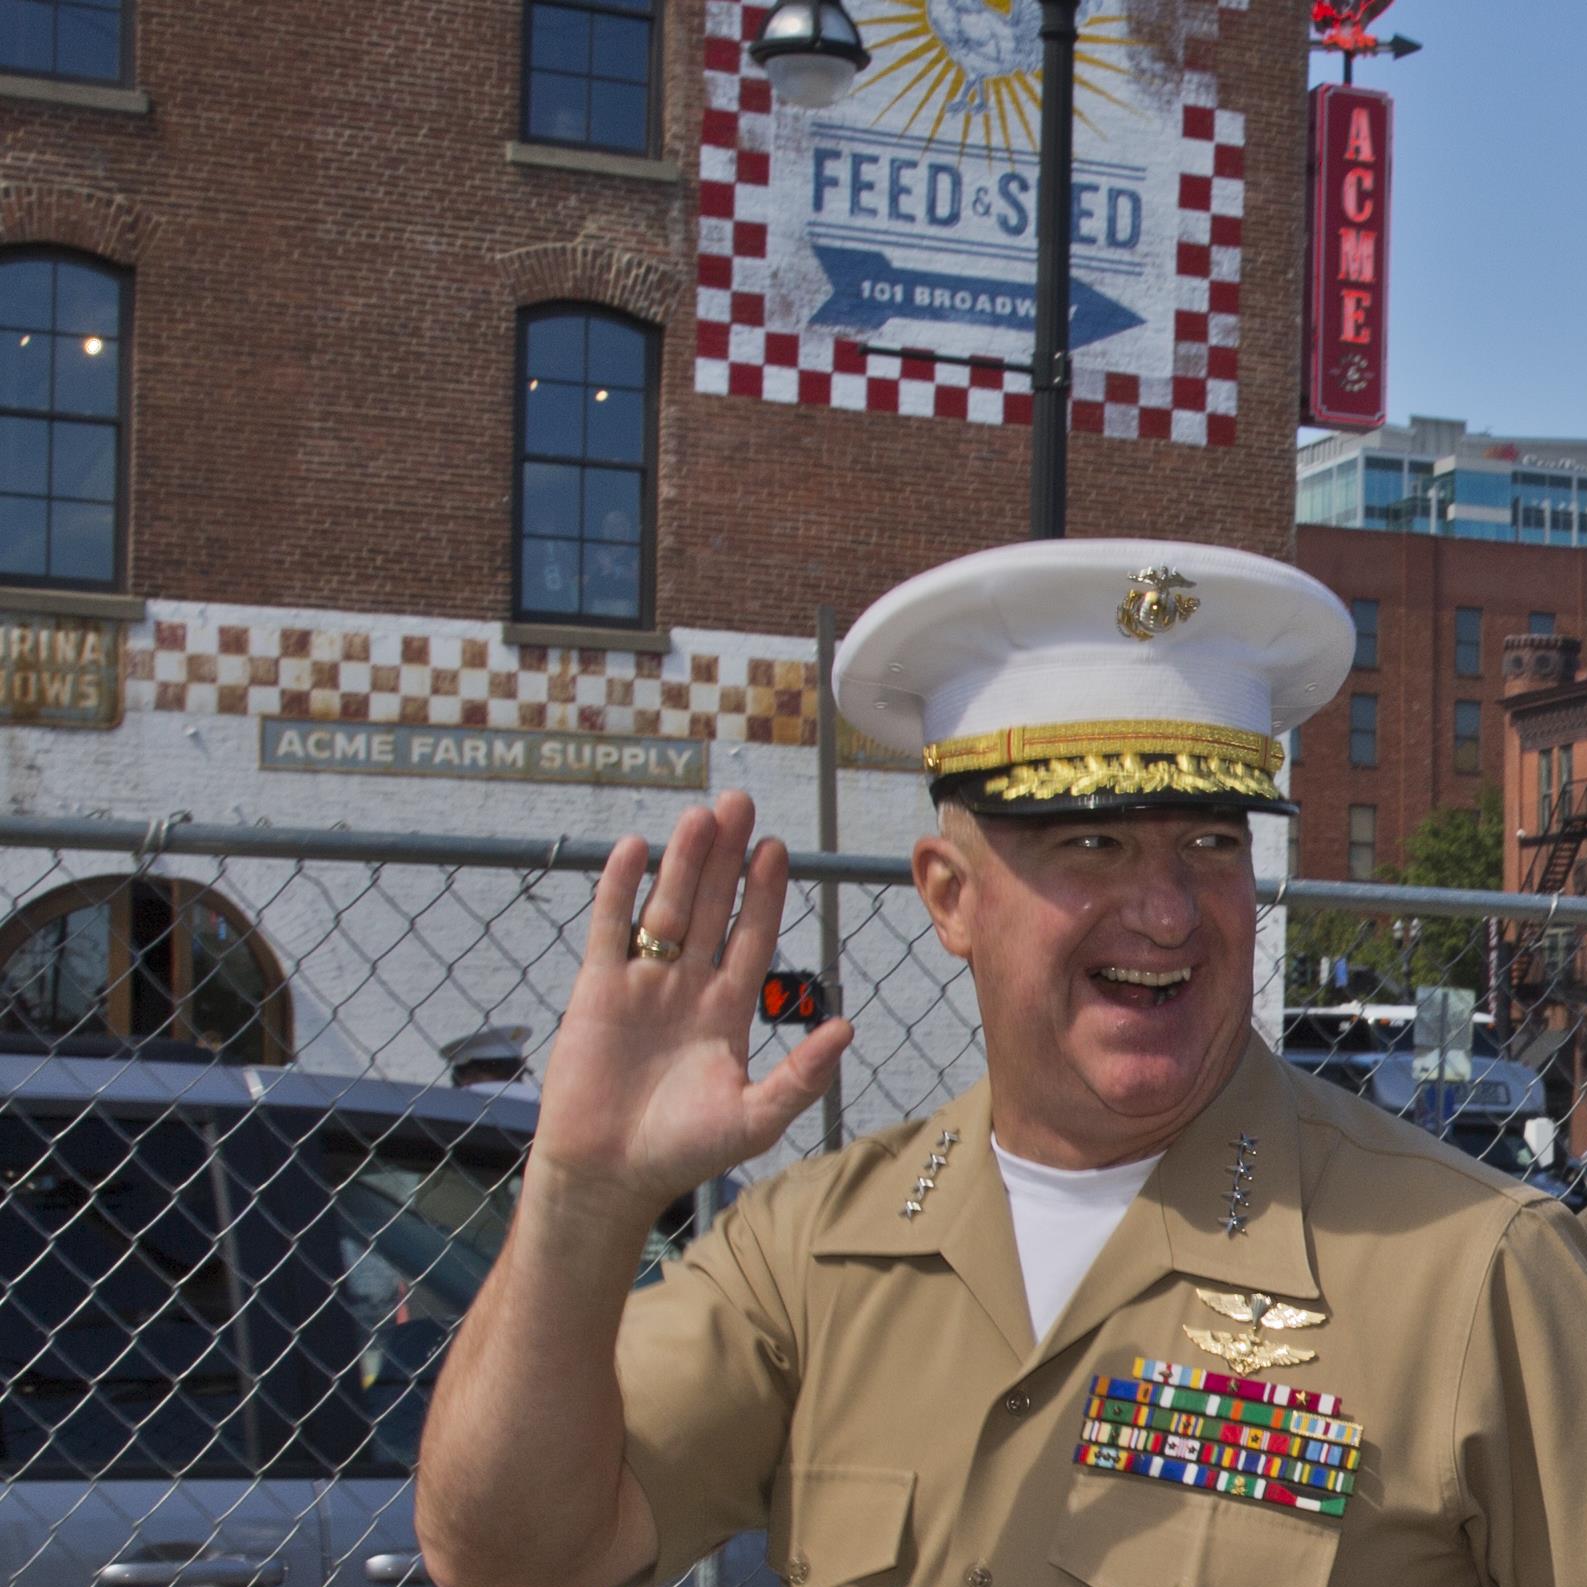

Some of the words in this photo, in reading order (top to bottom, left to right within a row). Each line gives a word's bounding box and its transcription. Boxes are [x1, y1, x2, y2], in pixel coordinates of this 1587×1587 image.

[812, 147, 963, 228] FEED
[972, 185, 993, 217] &
[997, 171, 1143, 250] SED
[1337, 107, 1377, 344] ACME
[860, 279, 905, 304] 101
[0, 627, 105, 667] RINA
[0, 668, 99, 708] OWS
[276, 730, 396, 763] ACME
[411, 736, 527, 768] FARM
[539, 740, 693, 777] SUPPLY
